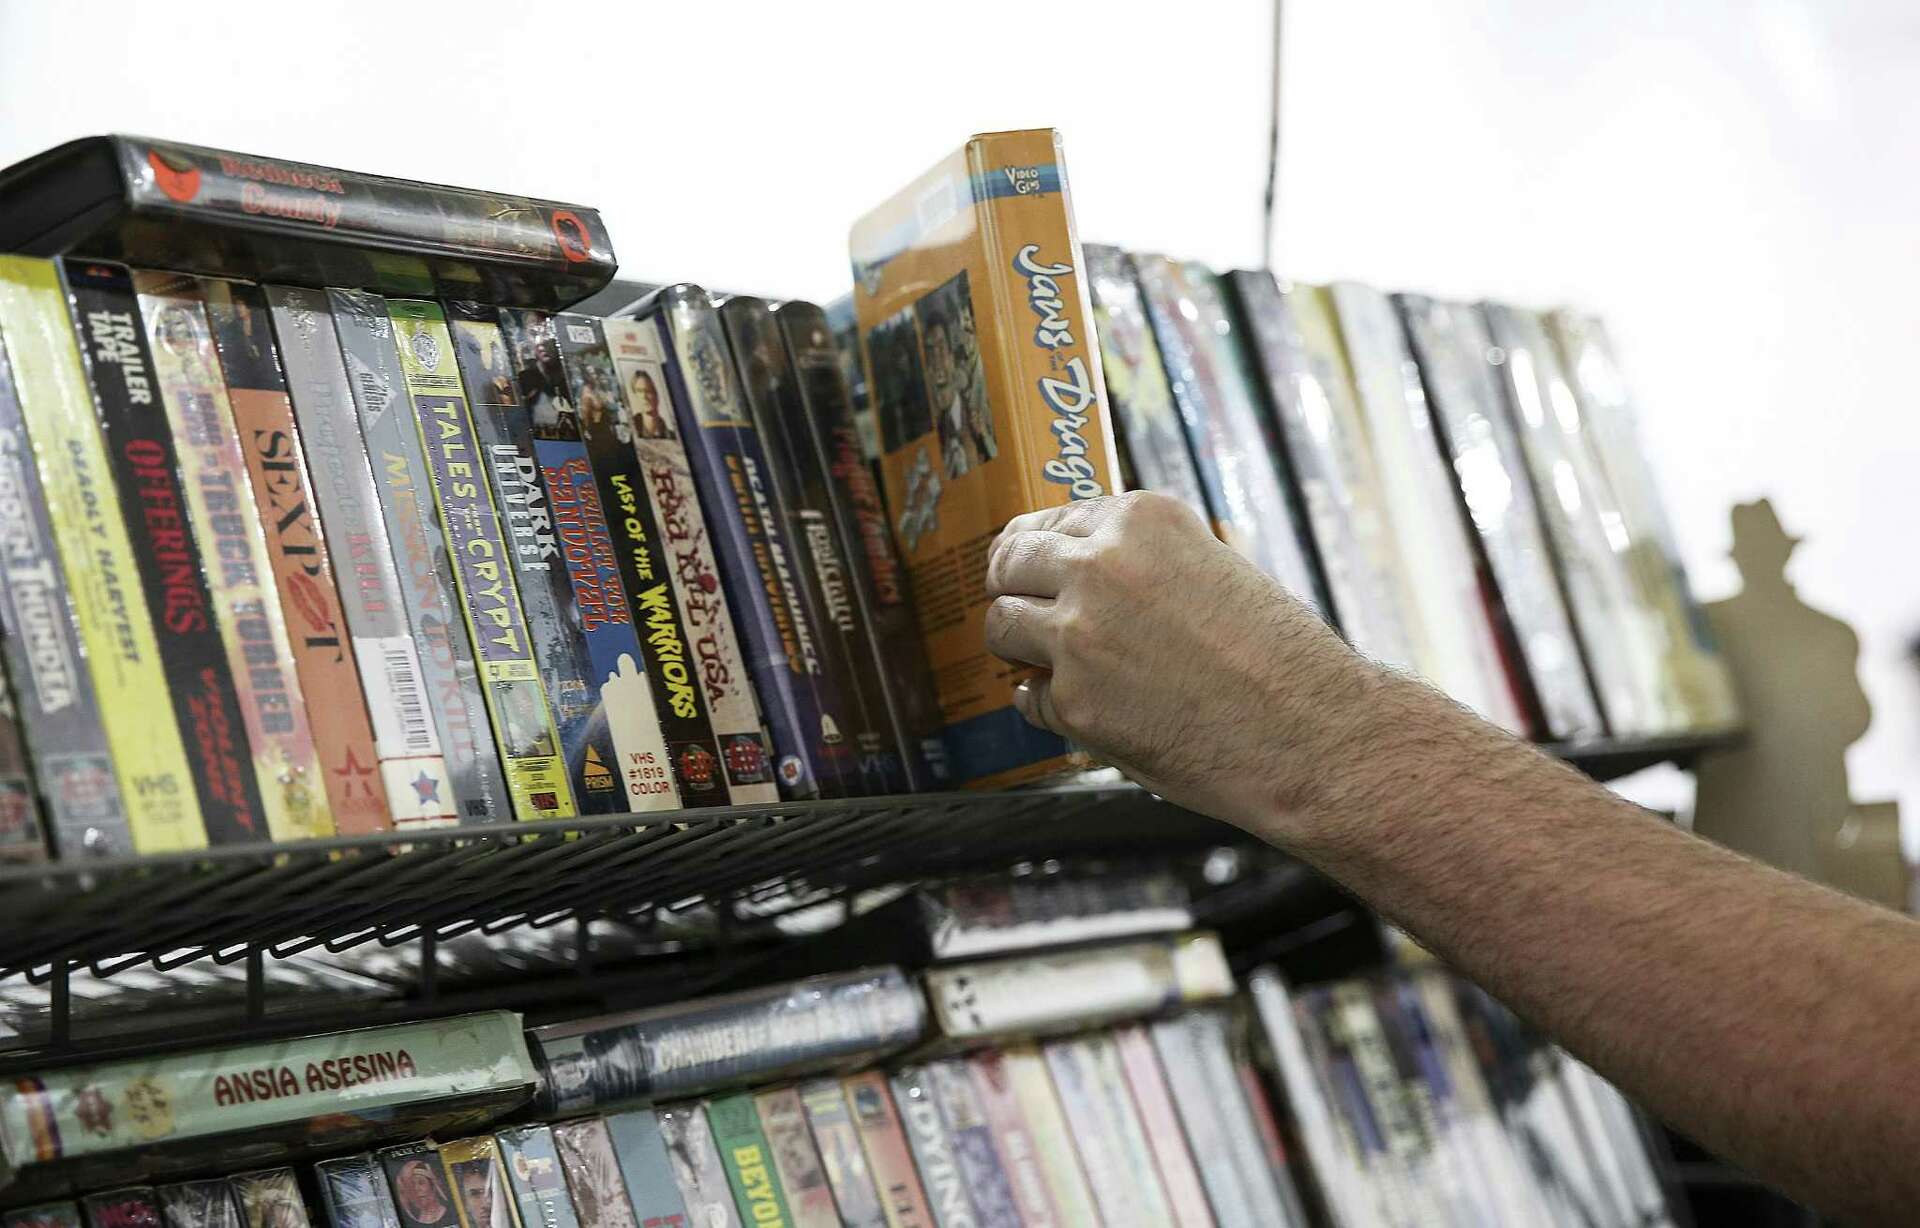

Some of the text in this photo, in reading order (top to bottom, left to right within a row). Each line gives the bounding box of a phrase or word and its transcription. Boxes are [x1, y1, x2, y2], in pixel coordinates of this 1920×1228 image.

[87, 311, 121, 363] TAPE
[114, 312, 152, 405] TRAILER
[1012, 244, 1102, 500] Jaws Drago
[66, 438, 108, 543] DEADLY
[95, 547, 141, 664] HARVEST
[125, 439, 208, 635] OFFERINGS
[382, 451, 441, 609] MISSION
[433, 401, 478, 499] TALES
[467, 538, 520, 653] CRYPT
[491, 443, 551, 572] UNIVERSE
[513, 454, 560, 559] DARK
[543, 466, 609, 633] SANDOVAL
[199, 470, 296, 735] TRUCK TURNER
[610, 473, 698, 721] LAST OF THE WARRIORS
[628, 766, 665, 780] #1819
[629, 751, 656, 765] VHS
[630, 780, 671, 796] COLOR
[213, 1049, 417, 1107] ANSIA ASESINA
